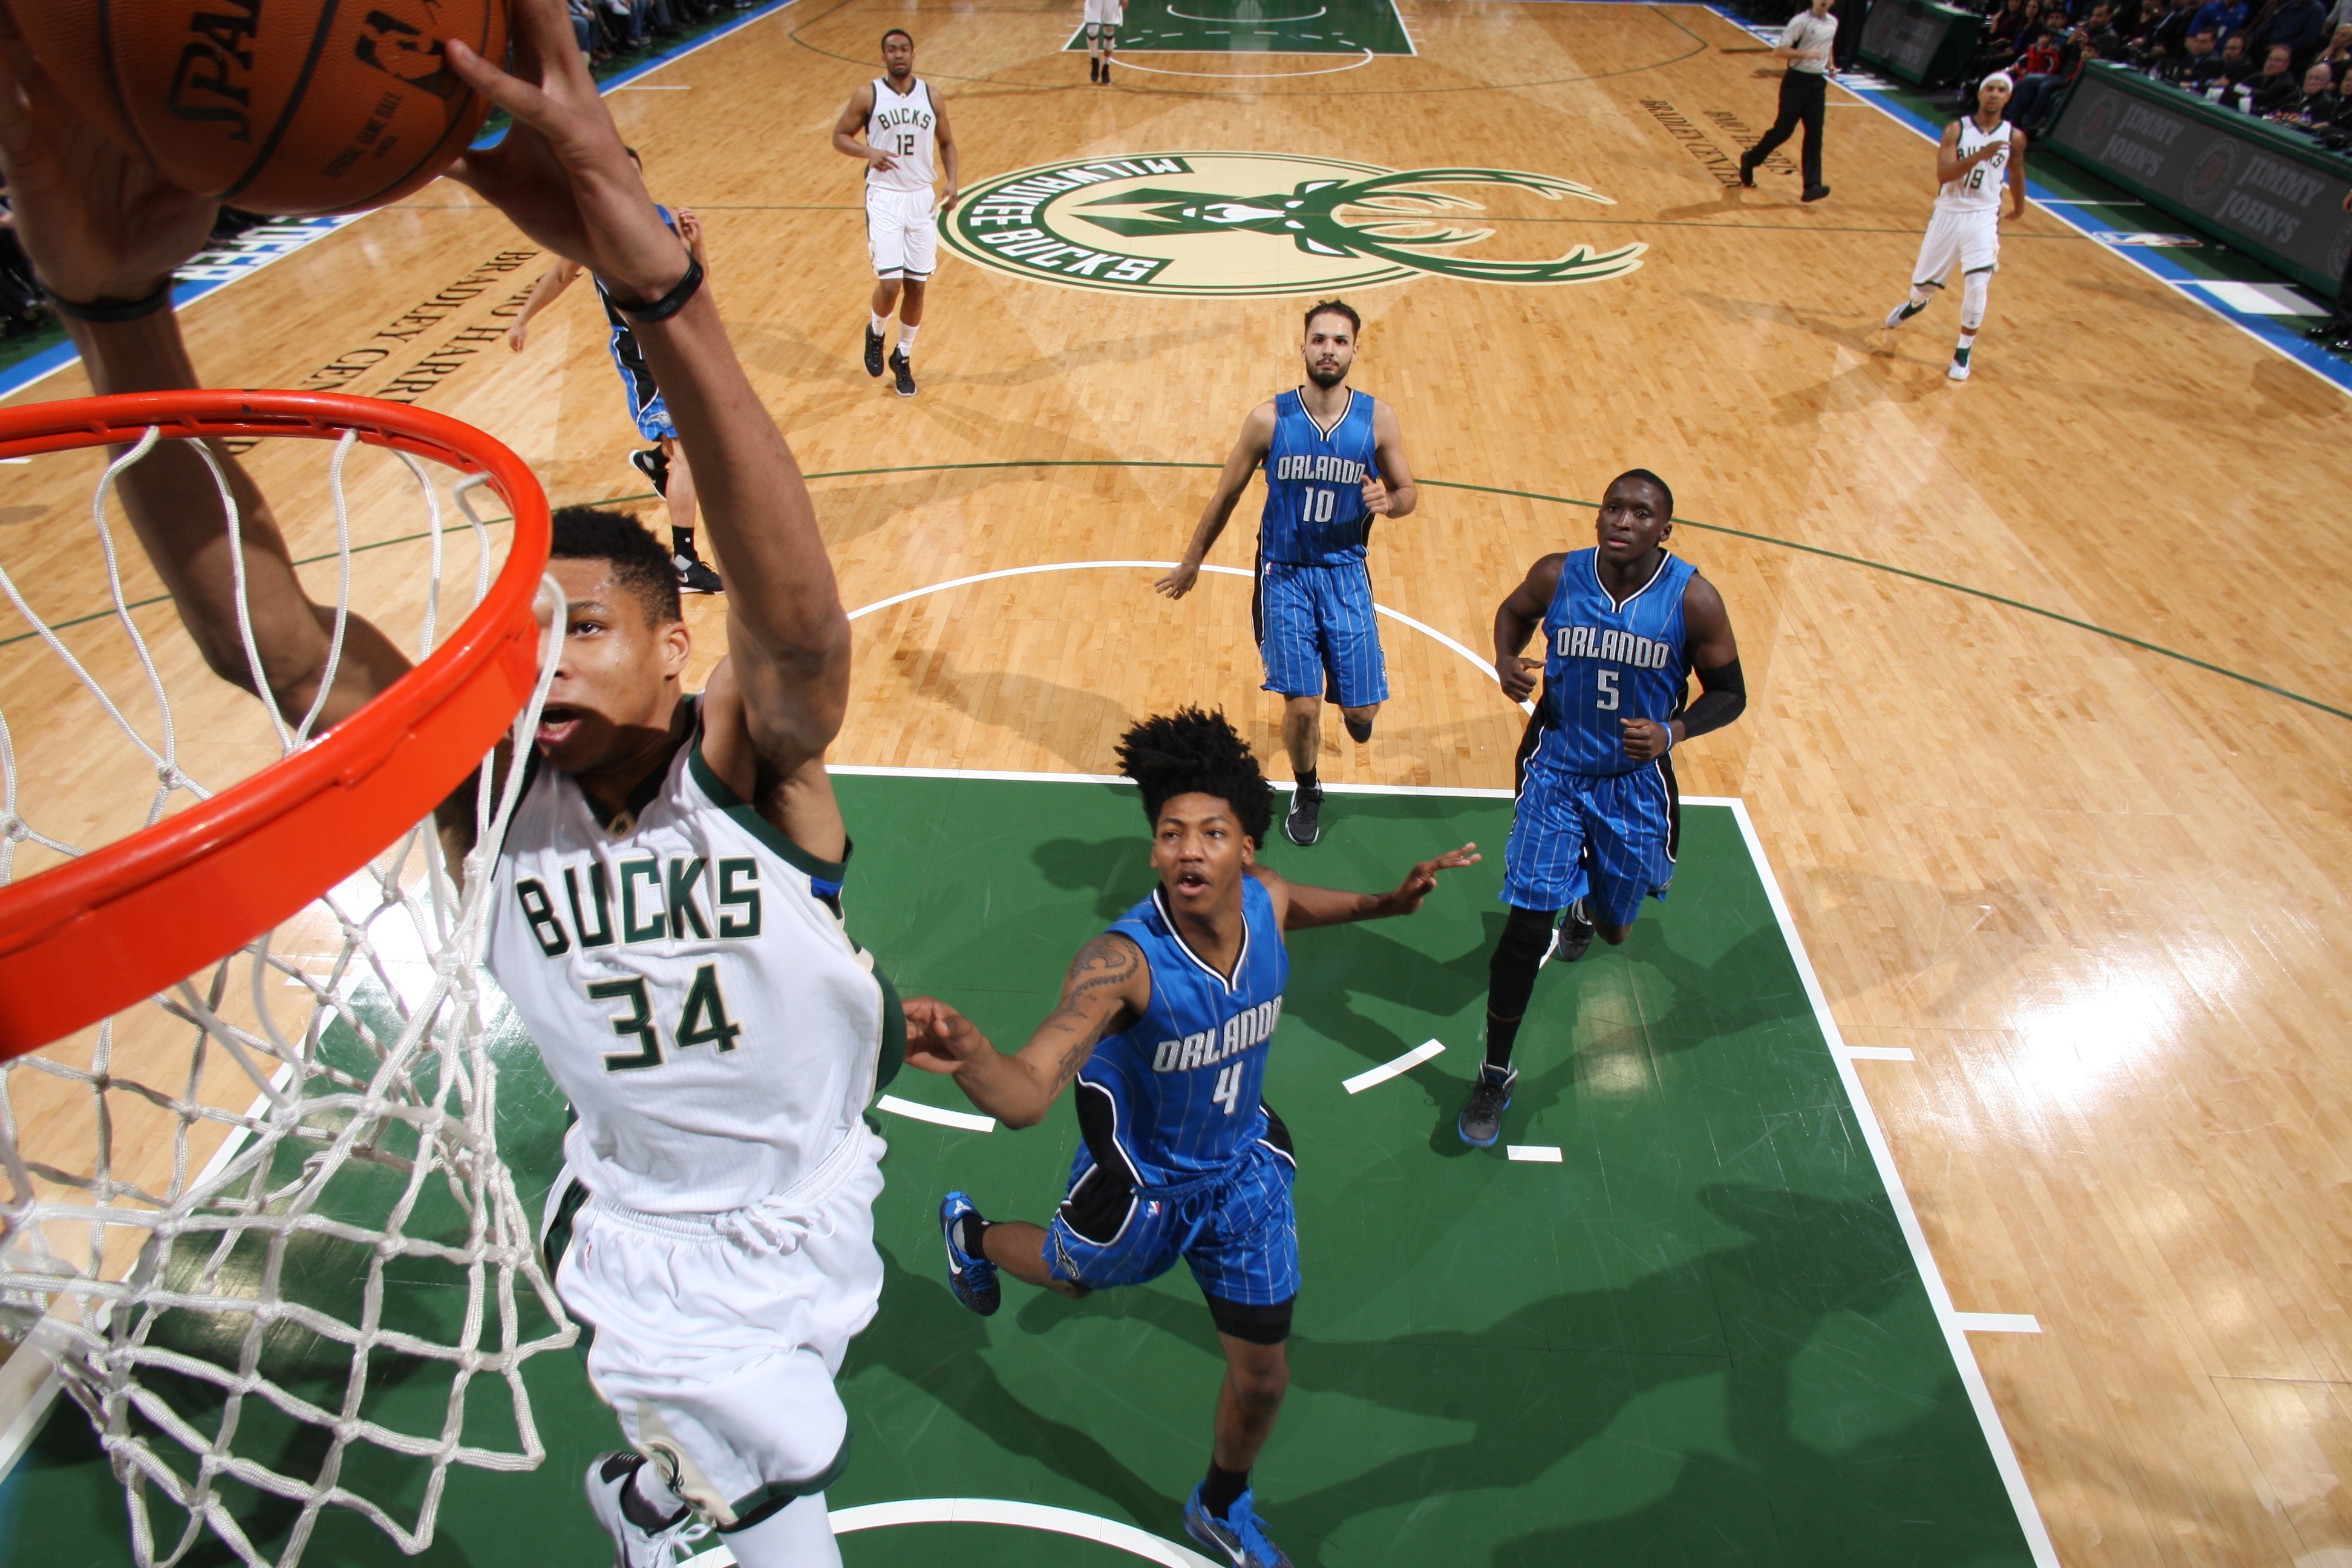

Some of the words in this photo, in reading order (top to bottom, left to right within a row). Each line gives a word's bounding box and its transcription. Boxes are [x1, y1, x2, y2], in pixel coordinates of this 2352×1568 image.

[877, 108, 932, 130] BUCKS
[1639, 100, 1709, 142] BRADLEY
[2115, 103, 2185, 145] JIMMY
[896, 134, 915, 155] 12
[2098, 134, 2165, 177] JOHN'S
[970, 158, 1183, 226] MILWAUKEE
[1964, 169, 1985, 189] 19
[2235, 155, 2326, 207] JIMMY
[2214, 189, 2301, 243] JOHN'S
[978, 229, 1160, 281] BUCKS
[371, 251, 543, 343] BRADLEY
[1276, 454, 1366, 485] ORLANDO
[1302, 486, 1335, 523] 10
[1556, 626, 1670, 669] ORLANDO
[1596, 668, 1620, 711] 5
[514, 854, 764, 959] BUCKS
[583, 959, 743, 1073] 34
[1212, 1060, 1245, 1116] 4
